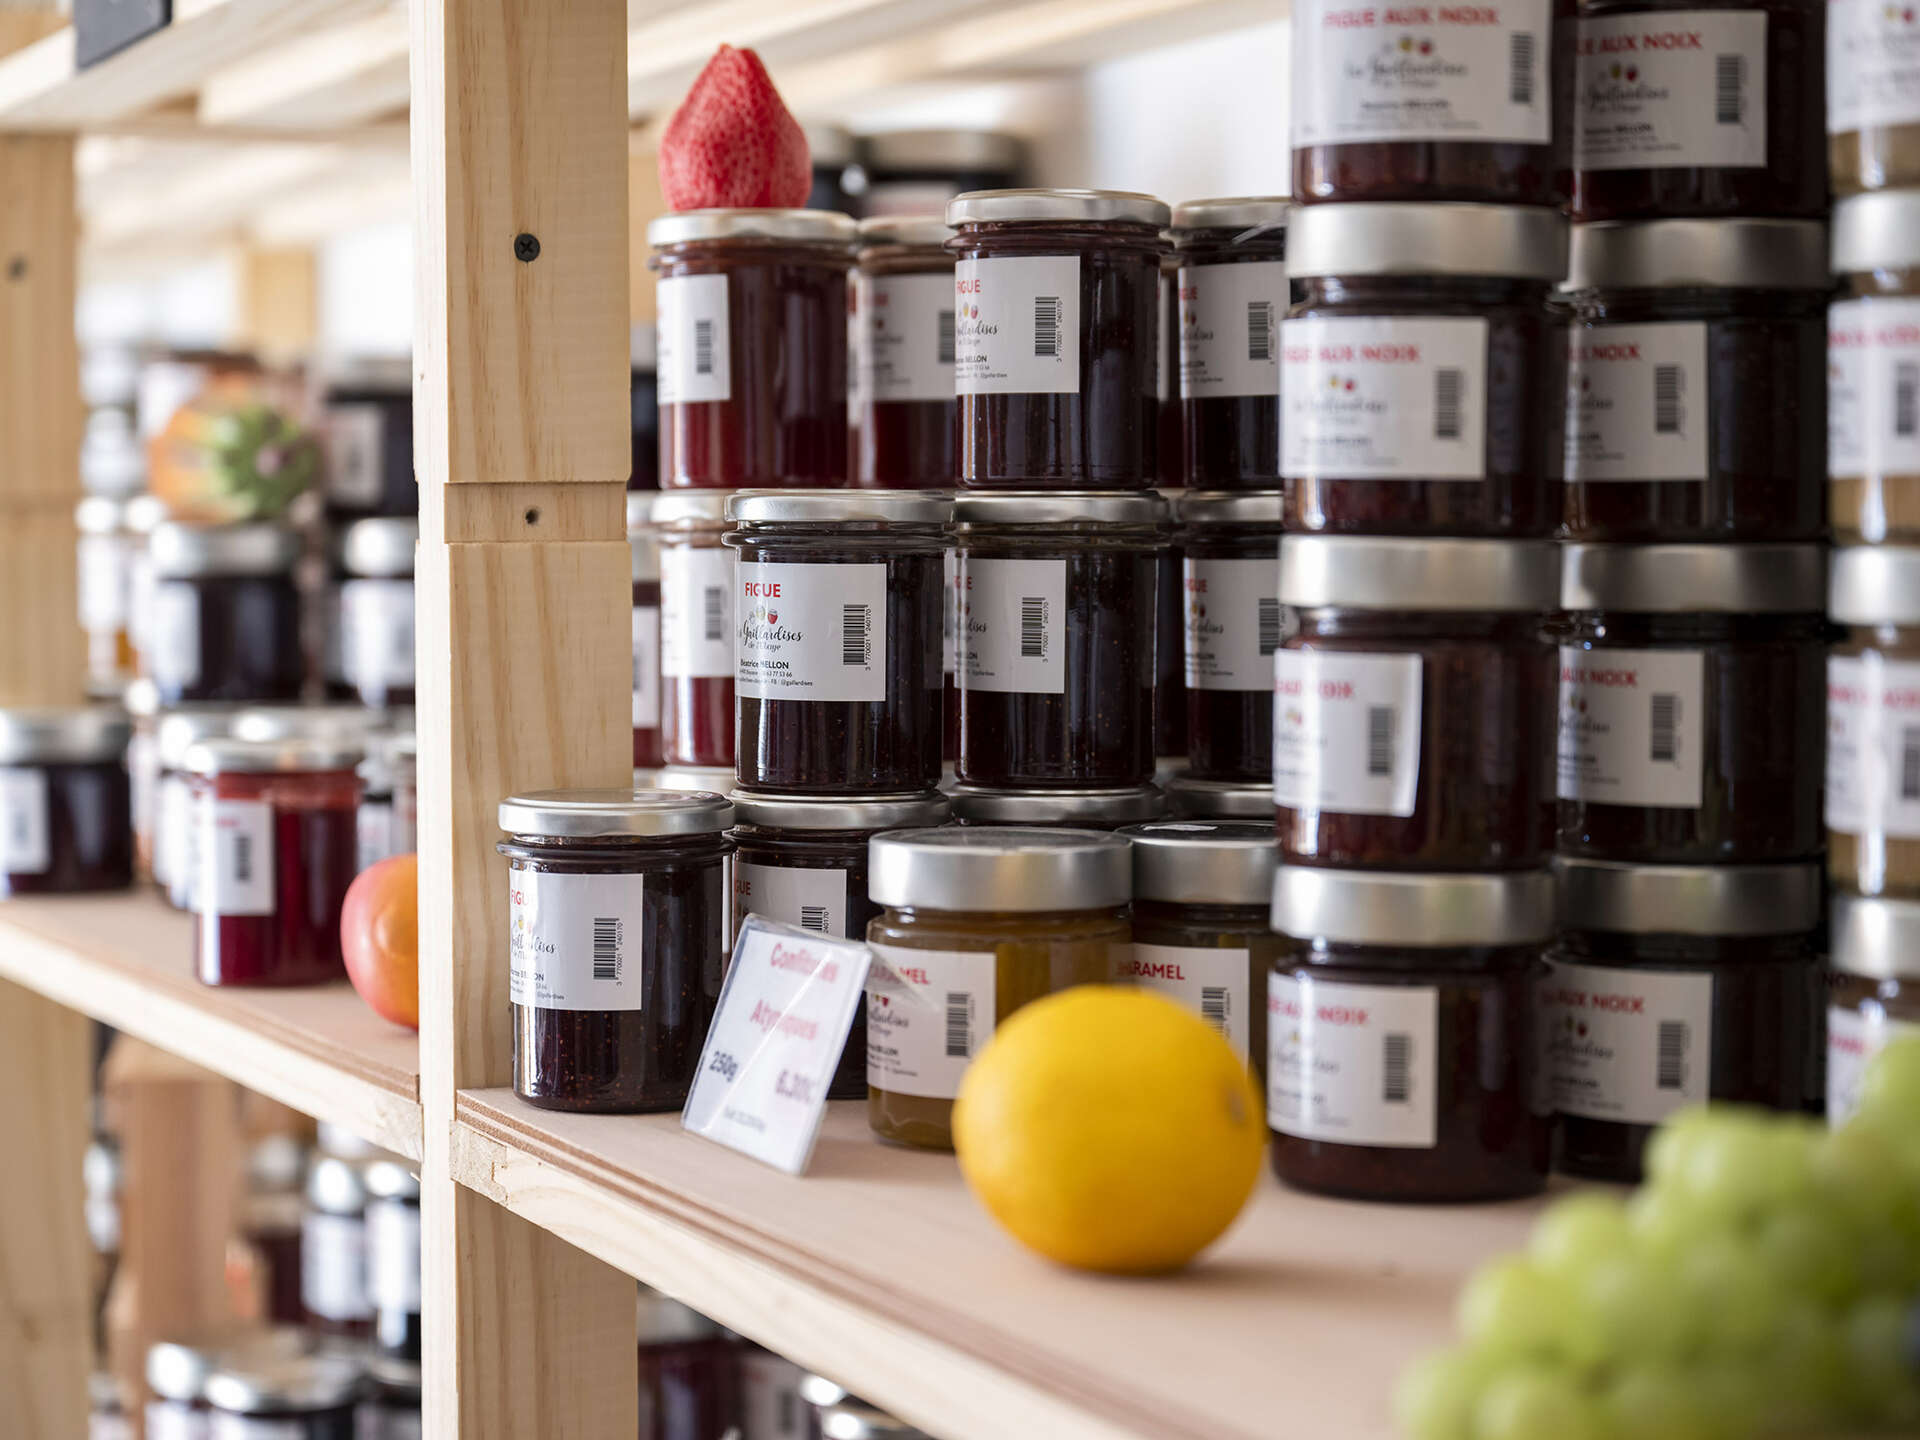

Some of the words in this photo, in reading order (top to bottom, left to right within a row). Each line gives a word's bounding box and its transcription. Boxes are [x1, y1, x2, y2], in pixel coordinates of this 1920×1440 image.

[1643, 32, 1702, 50] NOIX
[744, 582, 782, 598] FIGUE
[709, 1050, 739, 1083] 250g
